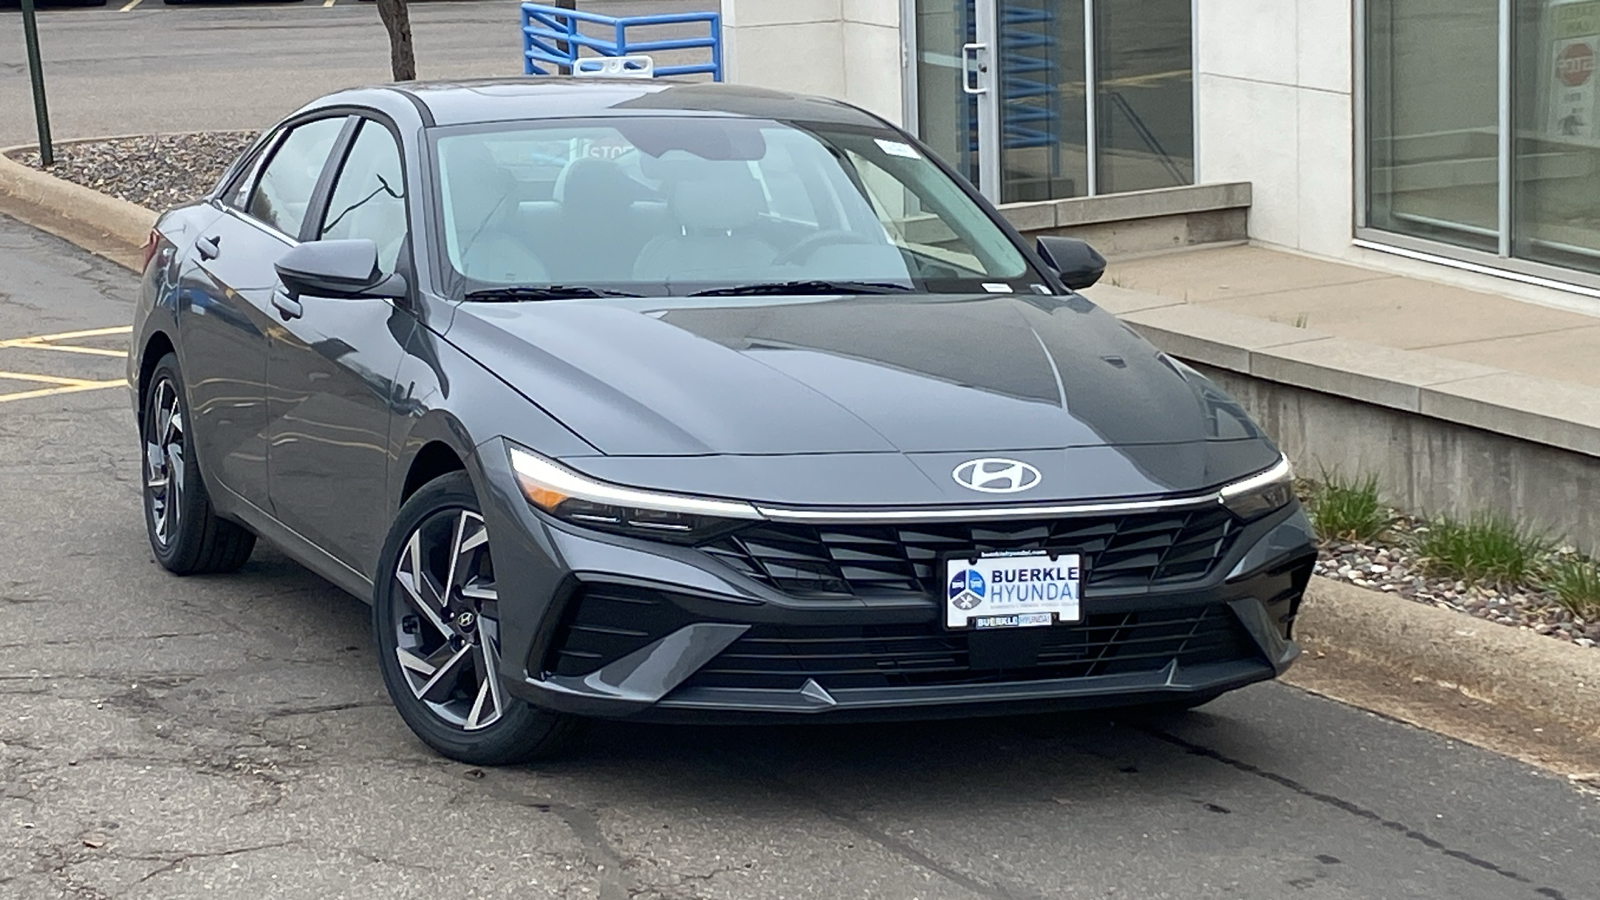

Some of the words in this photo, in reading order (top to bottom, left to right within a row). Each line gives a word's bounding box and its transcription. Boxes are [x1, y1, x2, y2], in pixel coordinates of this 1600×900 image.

[991, 567, 1079, 584] BUERKLE
[977, 616, 1018, 627] BUERKLE
[1019, 614, 1050, 624] HYUNDAI
